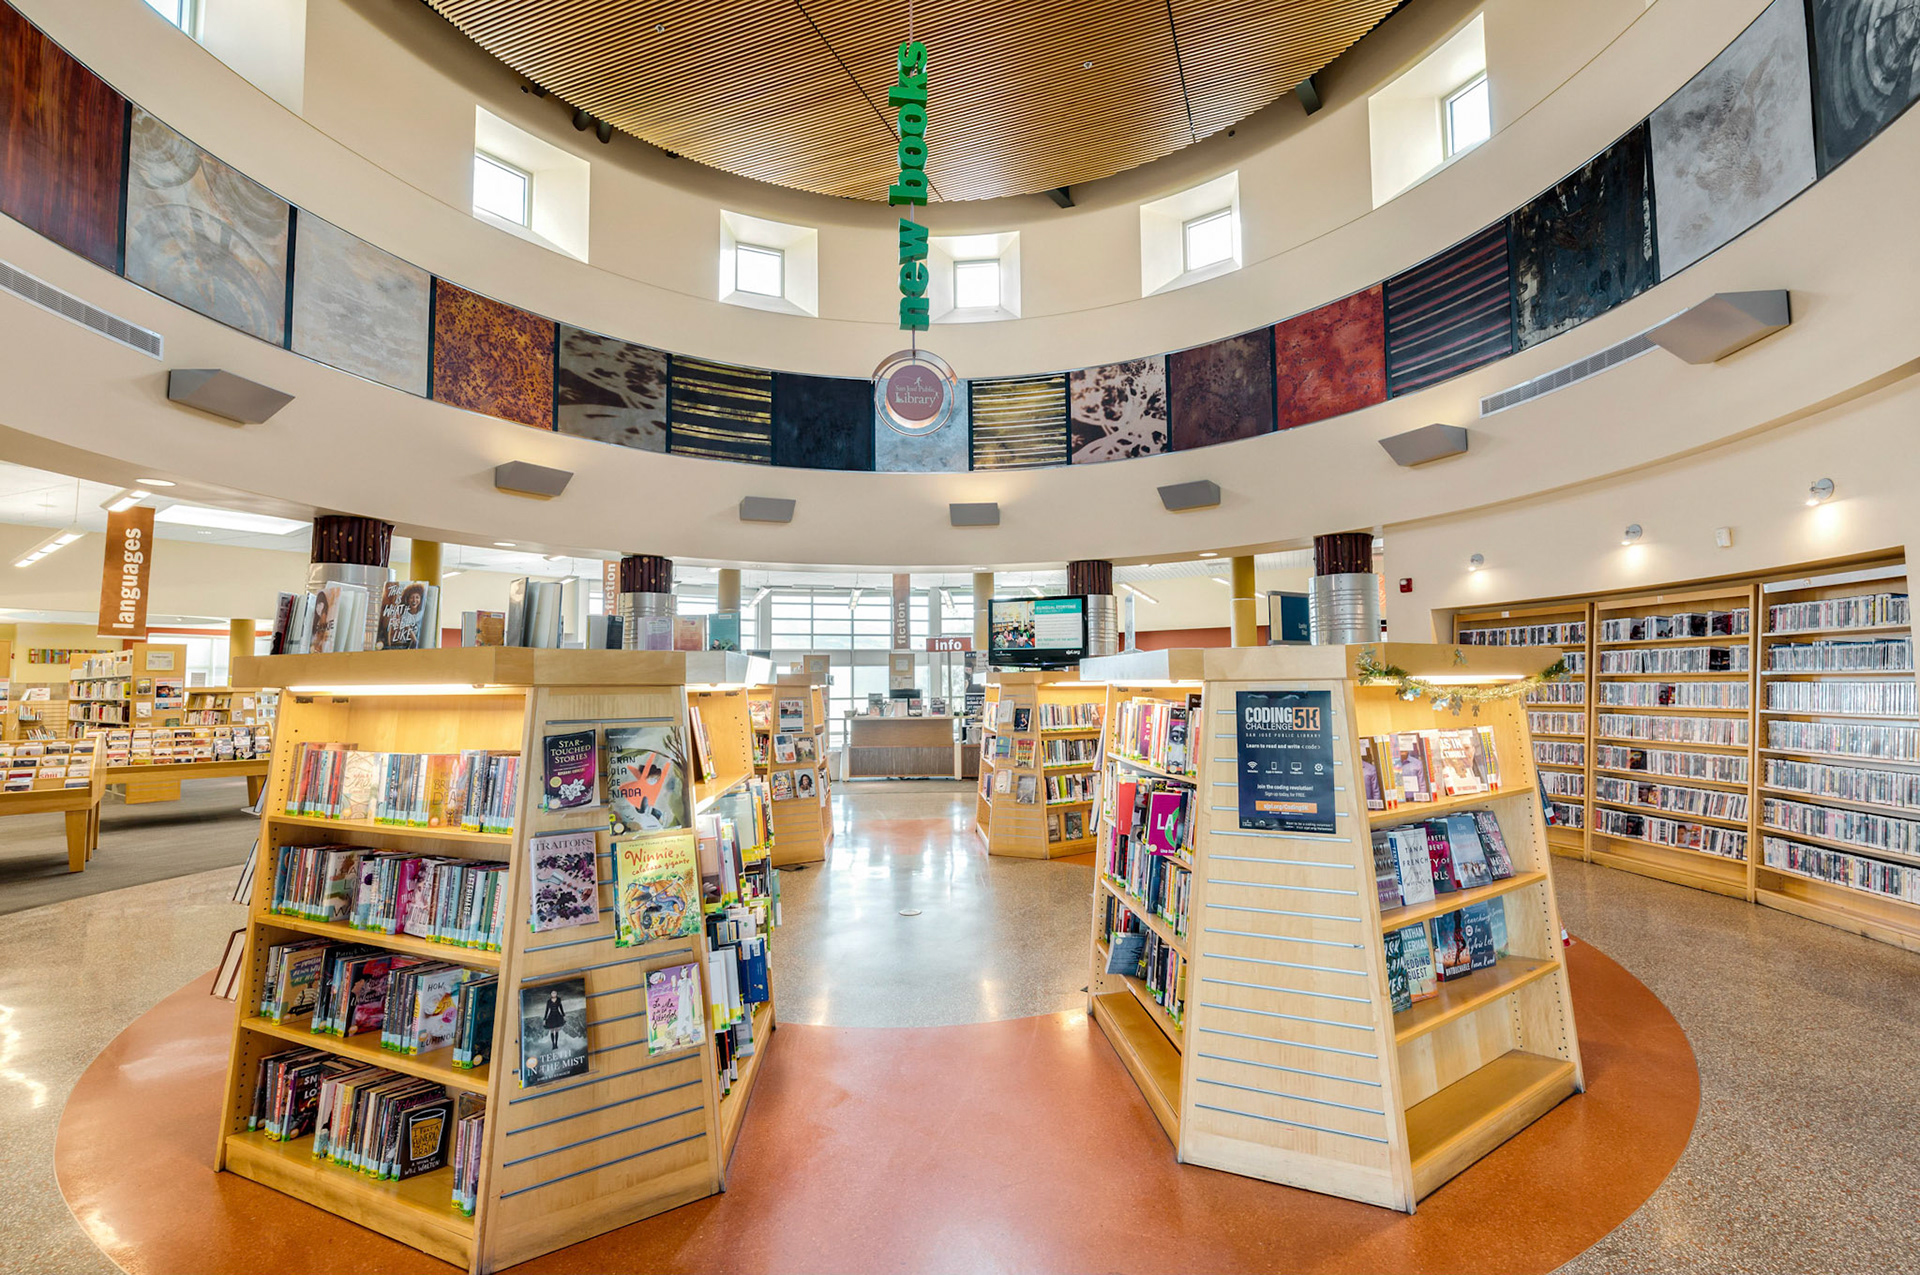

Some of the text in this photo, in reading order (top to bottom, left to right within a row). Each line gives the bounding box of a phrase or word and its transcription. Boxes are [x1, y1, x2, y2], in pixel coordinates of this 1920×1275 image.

[888, 41, 930, 331] new books
[895, 391, 937, 408] Library
[112, 527, 144, 629] languages
[605, 563, 616, 617] -fiction
[383, 604, 405, 618] WHAT
[897, 602, 906, 645] fiction
[934, 638, 962, 652] info
[1245, 706, 1319, 729] CODING 5K
[1245, 722, 1293, 731] CHALLENGE
[550, 744, 592, 756] TOUCHED
[558, 739, 584, 748] STAR-
[554, 753, 588, 764] STORIES
[610, 756, 636, 764] GRAN
[611, 779, 621, 787] DE
[612, 788, 642, 798] NADA
[1156, 813, 1174, 831] LA
[536, 838, 594, 852] TRAITOR'S
[1405, 845, 1423, 853] TANA
[1429, 843, 1444, 851] BERT
[624, 848, 674, 866] Winnie
[1402, 857, 1429, 866] FRENCH
[632, 859, 690, 876] calabaza gigante
[1433, 871, 1449, 880] RLS
[464, 872, 475, 916] AFTERIMAGE
[1464, 912, 1490, 924] Searching
[1401, 926, 1424, 940] NATHAN
[1403, 938, 1428, 953] LLERMAN
[1405, 955, 1430, 970] EDDING
[1407, 967, 1428, 980] GUEST
[427, 982, 446, 992] HOW
[420, 1033, 455, 1048] LUMINO
[540, 1050, 572, 1063] TEETH
[540, 1061, 560, 1073] THE
[562, 1055, 585, 1069] MIST
[418, 1160, 440, 1171] WALTON
